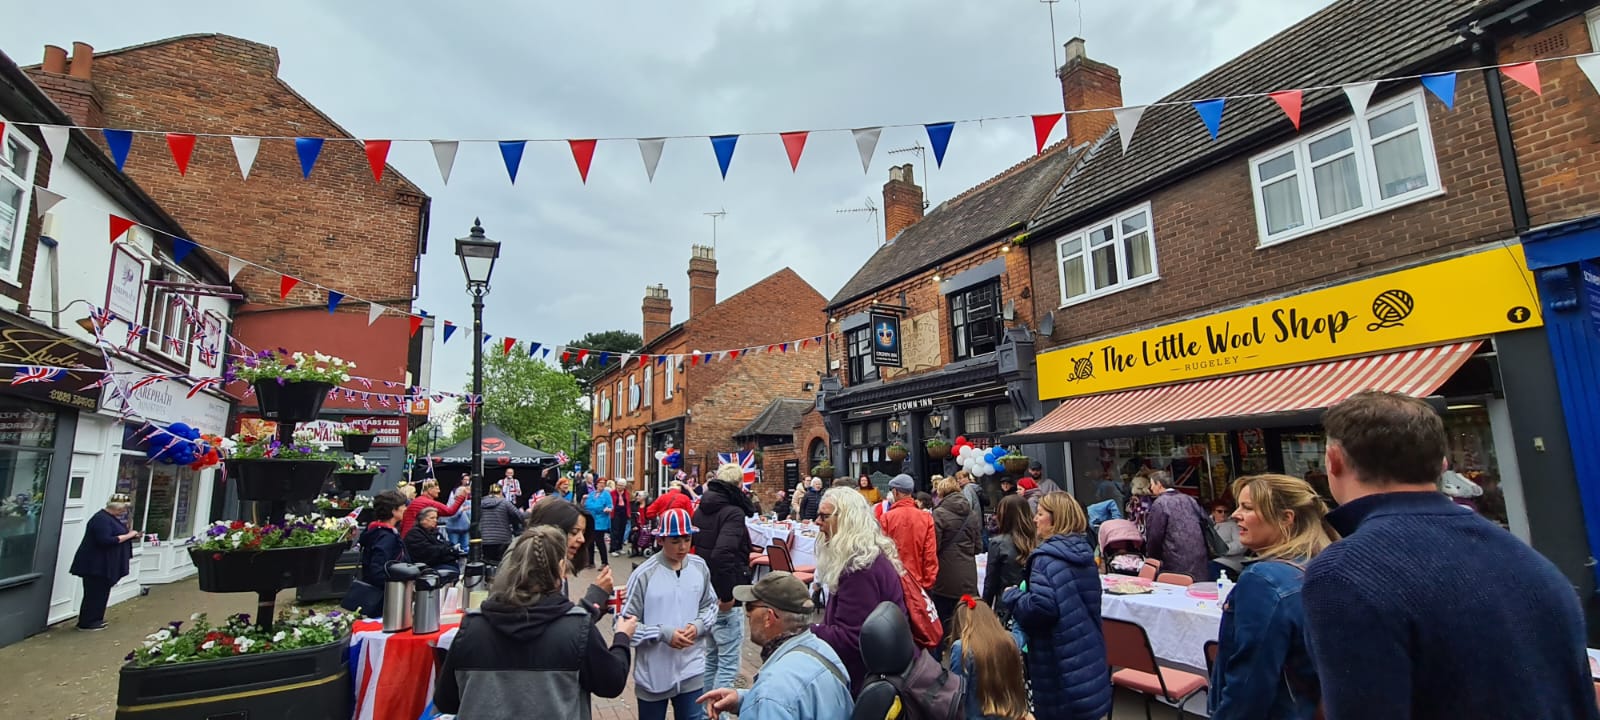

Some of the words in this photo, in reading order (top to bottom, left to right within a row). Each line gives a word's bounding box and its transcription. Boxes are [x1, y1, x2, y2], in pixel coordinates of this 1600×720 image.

[1101, 345, 1137, 373] The
[1142, 332, 1202, 368] Little
[1206, 316, 1266, 355] Wool
[1271, 308, 1358, 344] Shop
[1184, 355, 1240, 372] RUGELEY
[893, 401, 918, 412] CROWN
[919, 398, 933, 409] INN
